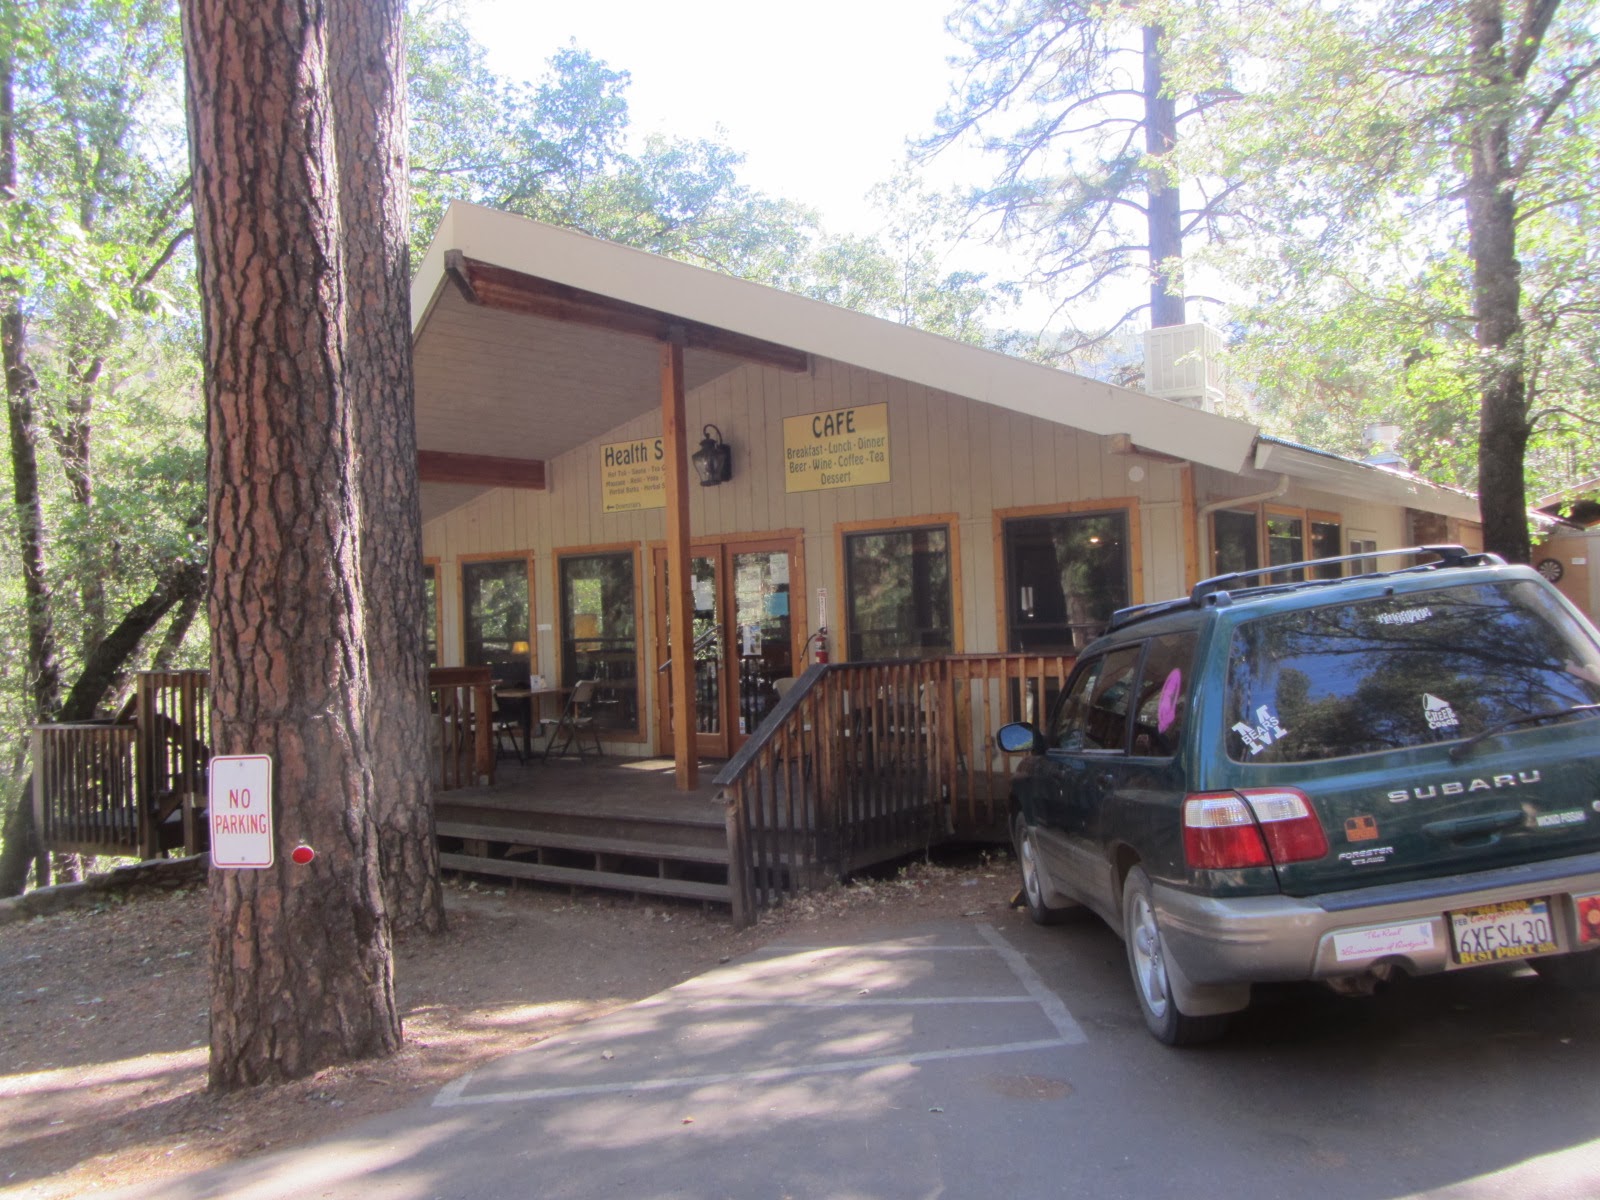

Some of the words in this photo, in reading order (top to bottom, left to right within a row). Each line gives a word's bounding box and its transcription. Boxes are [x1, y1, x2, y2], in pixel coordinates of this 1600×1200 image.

[812, 410, 856, 438] CAFE
[604, 442, 648, 467] Health
[654, 439, 664, 461] S
[786, 445, 823, 460] Breakfast
[828, 440, 852, 454] Lunch
[857, 437, 885, 450] Dinner
[789, 462, 807, 474] Beer
[812, 458, 832, 470] Wine
[838, 454, 864, 468] Coffee
[869, 450, 884, 463] Tea
[820, 471, 851, 485] Dessert
[1424, 707, 1456, 722] CHEER
[1241, 716, 1280, 746] BEARS
[1387, 770, 1541, 803] SUBARU
[229, 788, 251, 809] NO
[215, 813, 267, 834] PARKING
[1338, 846, 1393, 860] FORESTER
[1460, 918, 1548, 954] 6XFS430
[1460, 949, 1494, 964] BEST
[1495, 943, 1537, 959] PRICE
